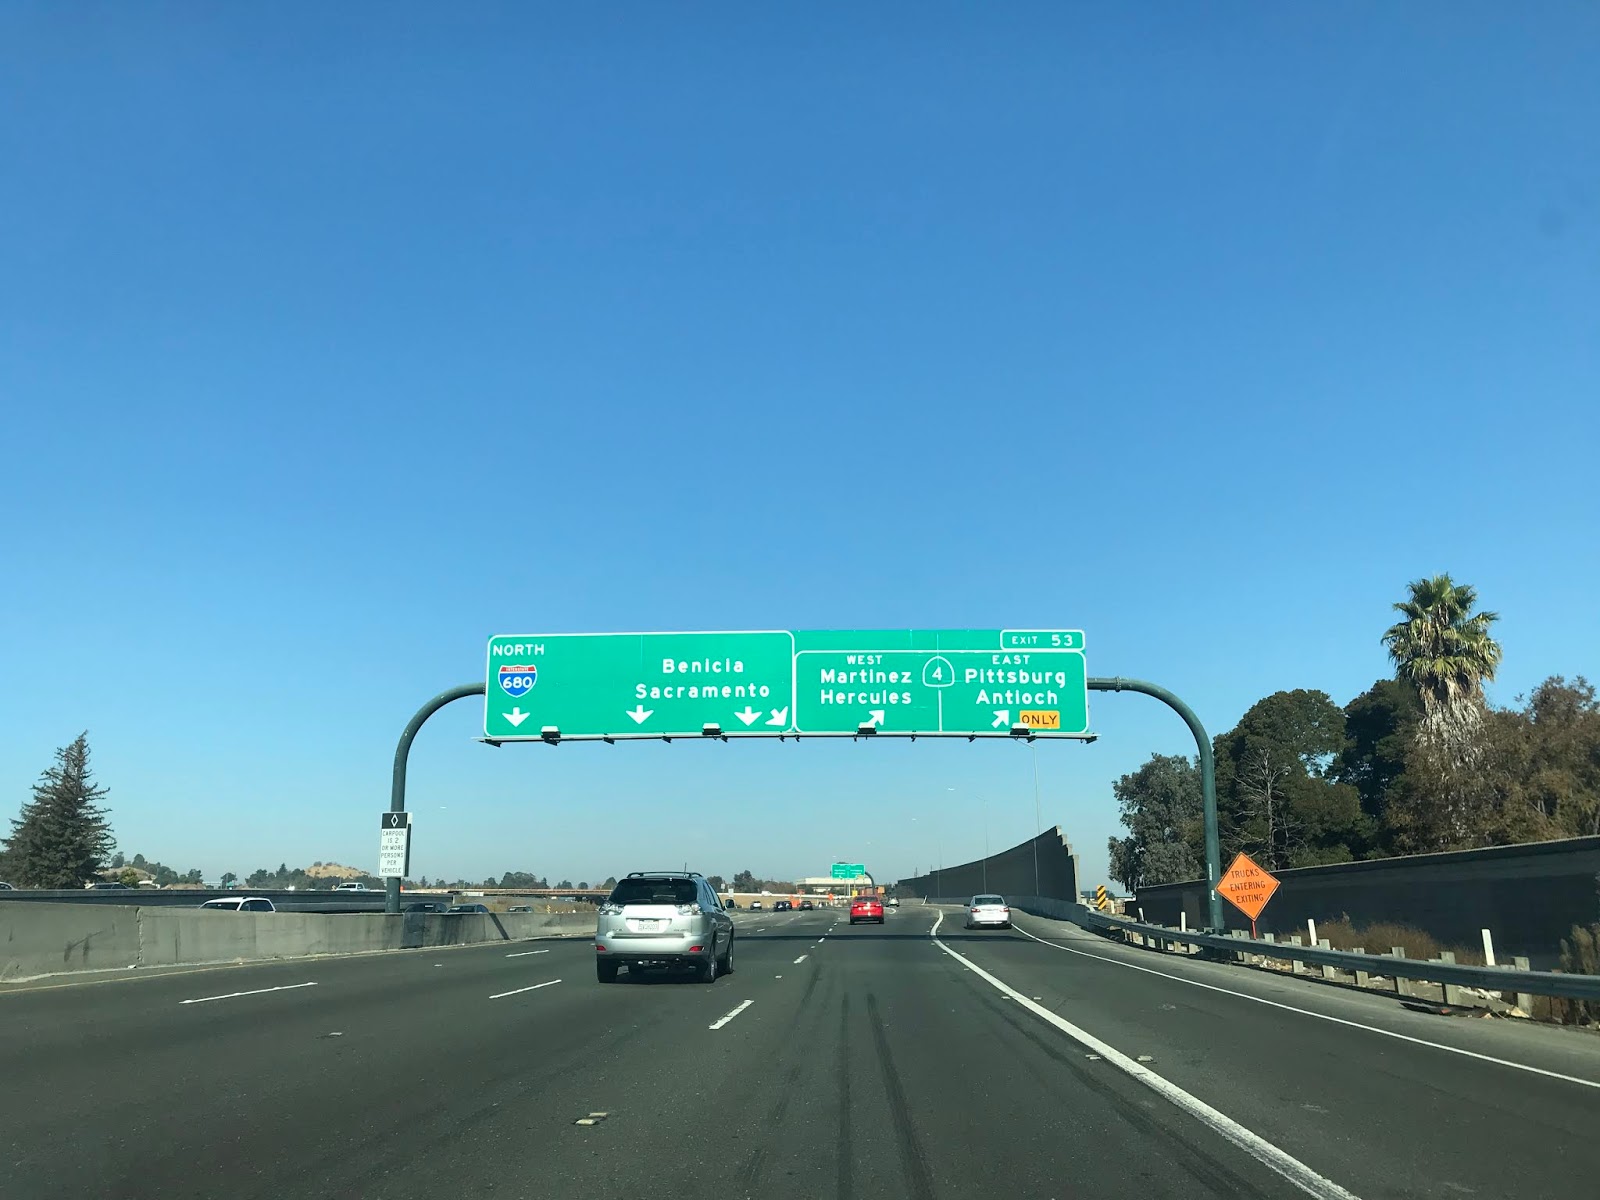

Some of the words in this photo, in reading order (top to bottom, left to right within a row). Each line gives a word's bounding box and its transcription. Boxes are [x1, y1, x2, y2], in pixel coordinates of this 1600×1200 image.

[1011, 636, 1038, 645] EXIT
[1051, 634, 1073, 647] 53
[492, 643, 545, 656] NORTH
[662, 657, 744, 674] Benicia
[846, 655, 883, 665] WEST
[991, 655, 1030, 665] EAST
[820, 668, 912, 684] Martinez
[931, 666, 943, 681] 4
[964, 668, 1066, 689] Pittsburg
[502, 676, 533, 689] 680
[635, 682, 770, 699] Sacramento
[820, 689, 912, 705] Hercules
[975, 689, 1058, 705] Antioch
[1021, 714, 1058, 725] ONLY
[1230, 868, 1260, 879] TRUCKS
[1229, 880, 1266, 892] ENTERING
[1235, 893, 1264, 904] EXITING
